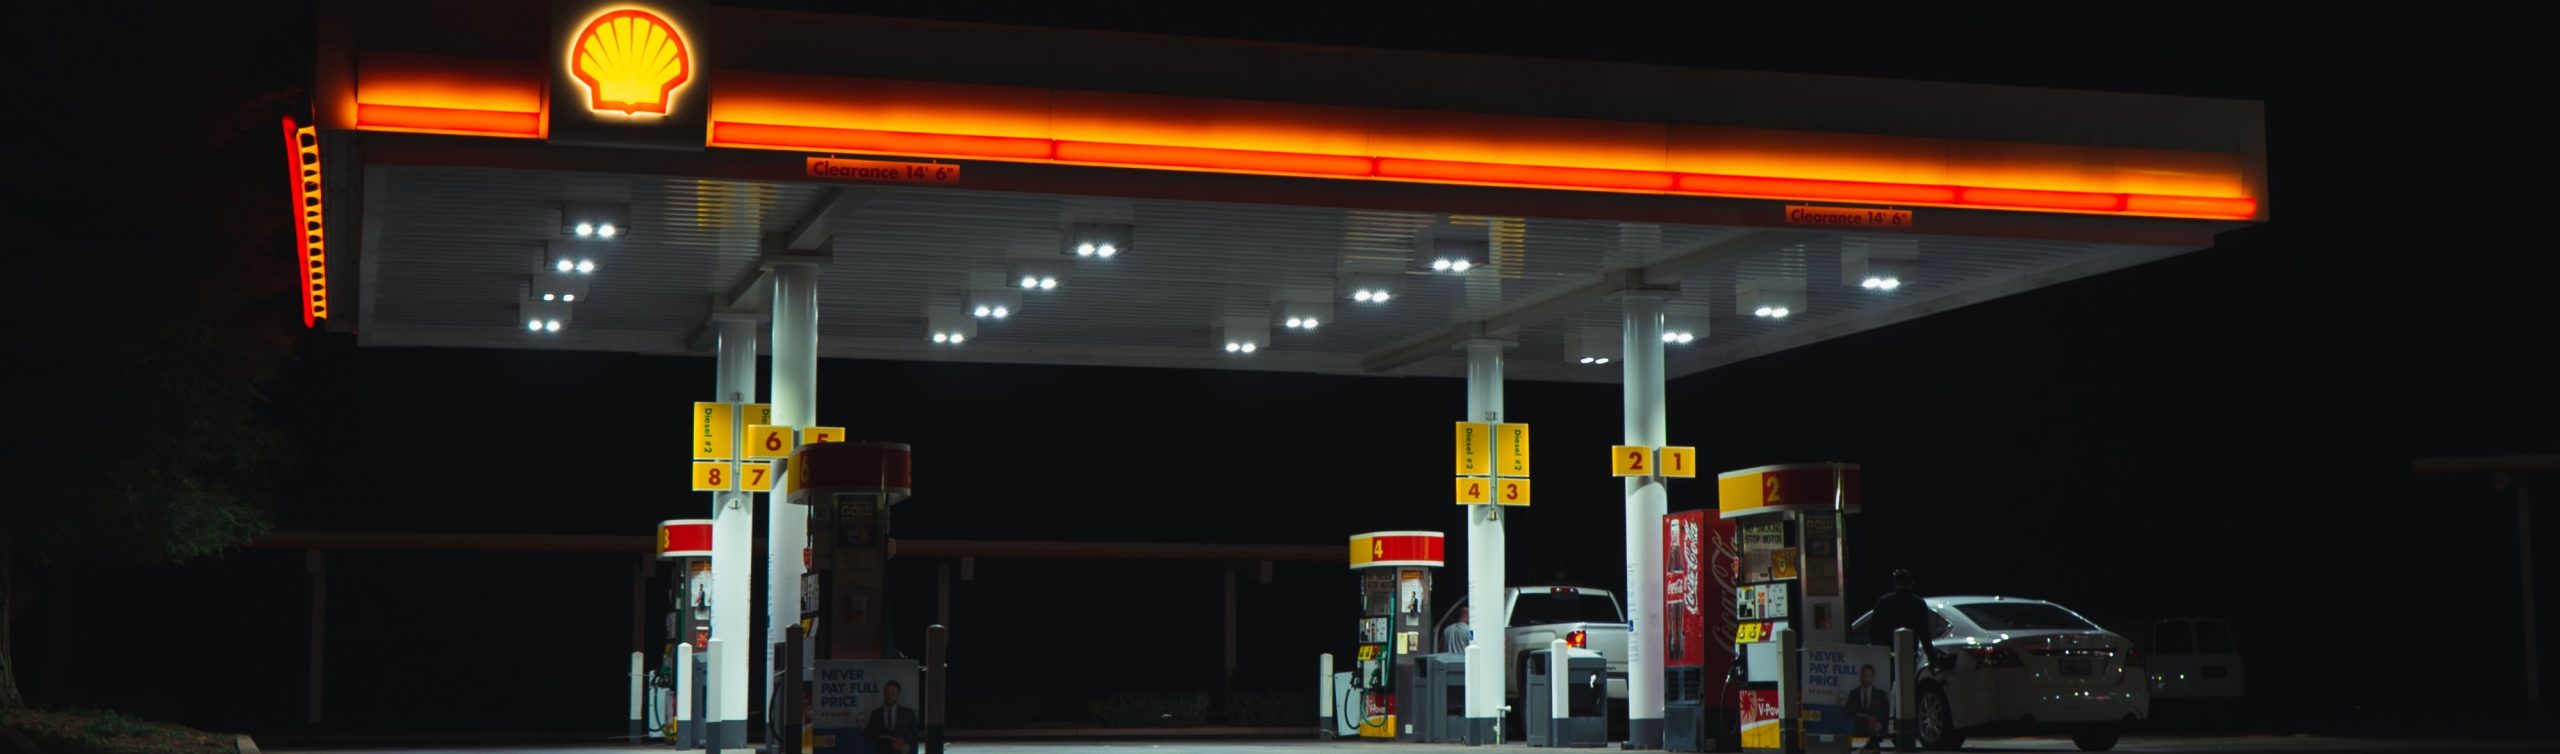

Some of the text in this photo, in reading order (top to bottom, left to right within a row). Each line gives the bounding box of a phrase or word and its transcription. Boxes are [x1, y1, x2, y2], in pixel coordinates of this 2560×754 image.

[813, 161, 954, 180] Clearance 14' 6"
[1791, 208, 1907, 225] Clearance 14' 6"
[704, 408, 713, 453] Diesel #2
[765, 431, 781, 451] 6
[1465, 428, 1473, 455] Diesel
[1514, 429, 1522, 456] Diesel
[1629, 451, 1643, 470] 2
[1673, 453, 1681, 470] 1
[708, 468, 721, 485] 8
[752, 469, 765, 485] 7
[1468, 483, 1480, 498] 4
[1506, 483, 1518, 500] 3
[1766, 476, 1780, 502] 2
[1373, 539, 1383, 559] 4
[1684, 519, 1699, 614] Coca-Cola
[1808, 651, 1844, 662] NEVER
[821, 669, 864, 681] NEVER
[1808, 663, 1858, 675] PAY FULL
[821, 682, 880, 693] PAY FULL
[1808, 675, 1839, 686] PRICE
[821, 696, 857, 707] PRICE
